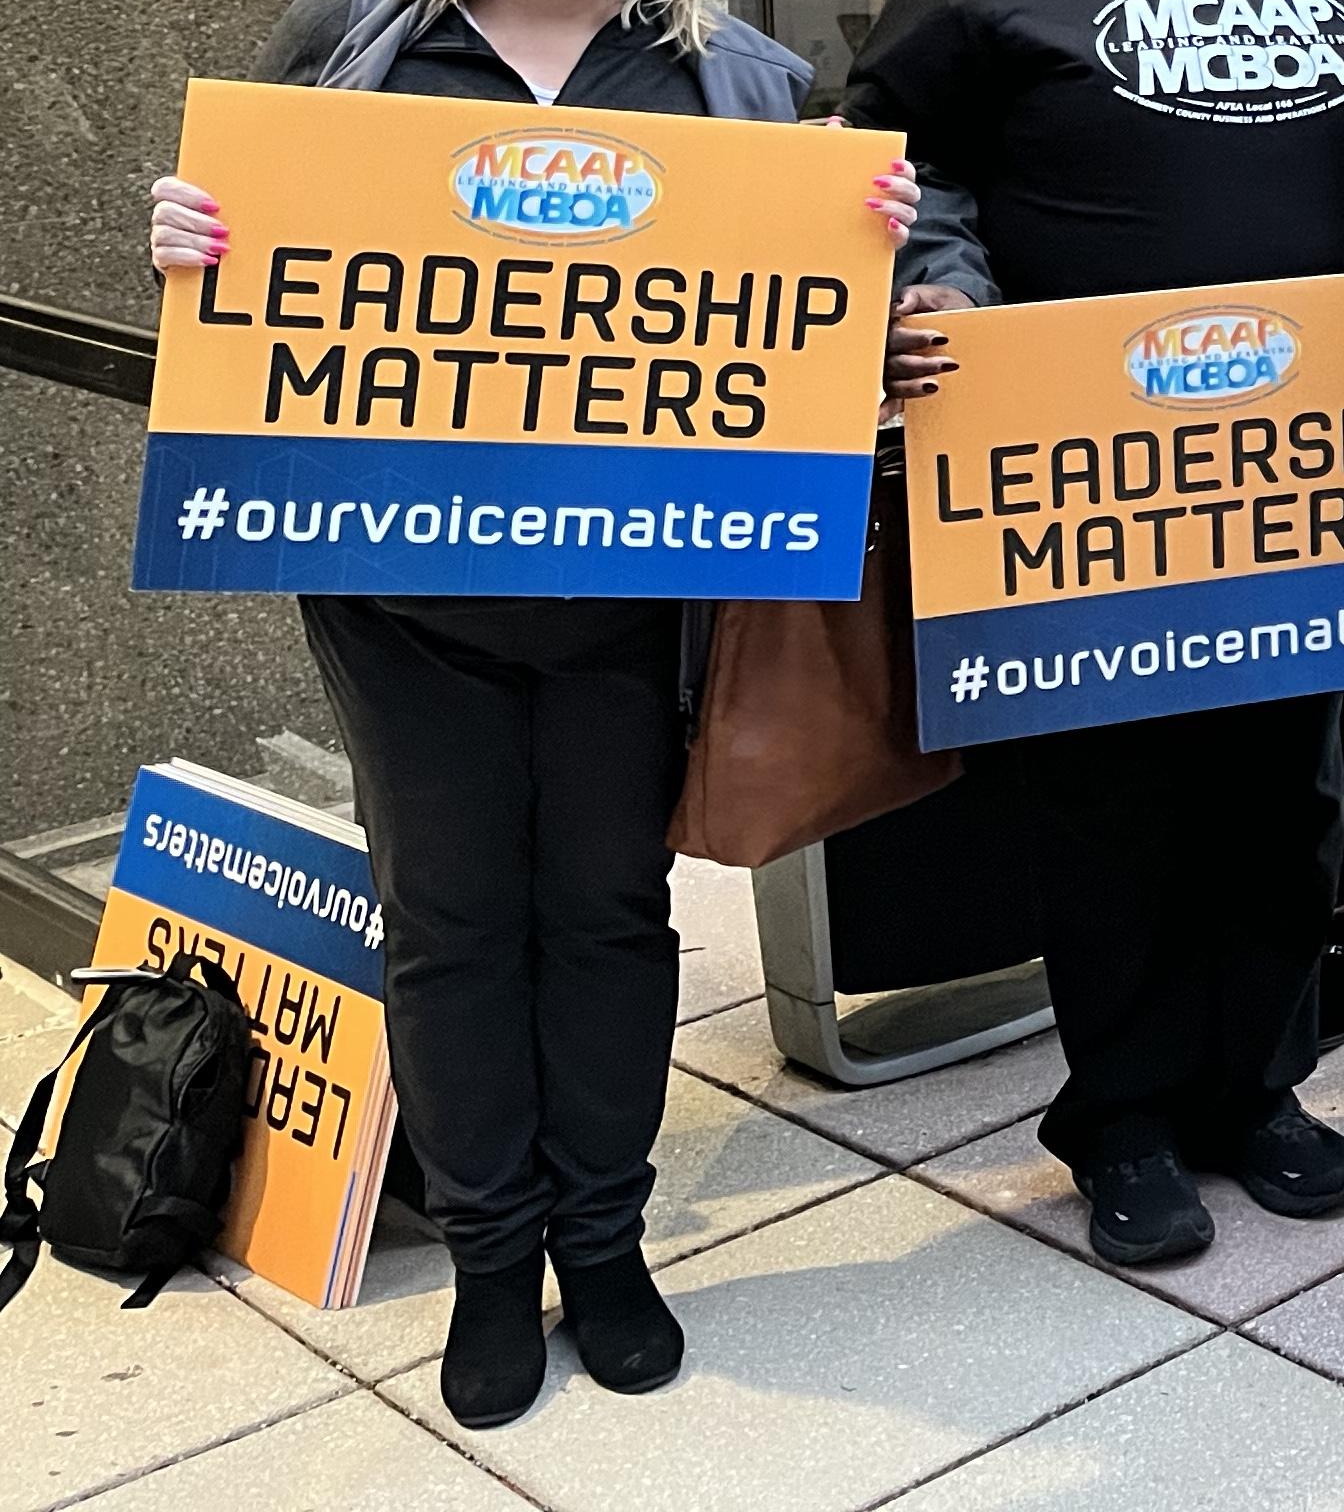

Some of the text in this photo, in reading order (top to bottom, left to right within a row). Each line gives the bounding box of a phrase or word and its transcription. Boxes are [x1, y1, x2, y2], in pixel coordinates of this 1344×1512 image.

[1108, 35, 1205, 54] LEADING
[1215, 34, 1256, 46] AND
[457, 174, 653, 197] LEADING AND LEARNING
[474, 143, 645, 186] MCAAP
[470, 185, 635, 229] MCBOA
[198, 247, 849, 351] LEADERSHIP
[1143, 318, 1283, 361] MCAAP
[263, 342, 767, 440] MATTERS
[1145, 355, 1280, 397] MCBOA
[177, 486, 821, 553] #ourvoicematters
[143, 813, 385, 951] #ourvoicematters
